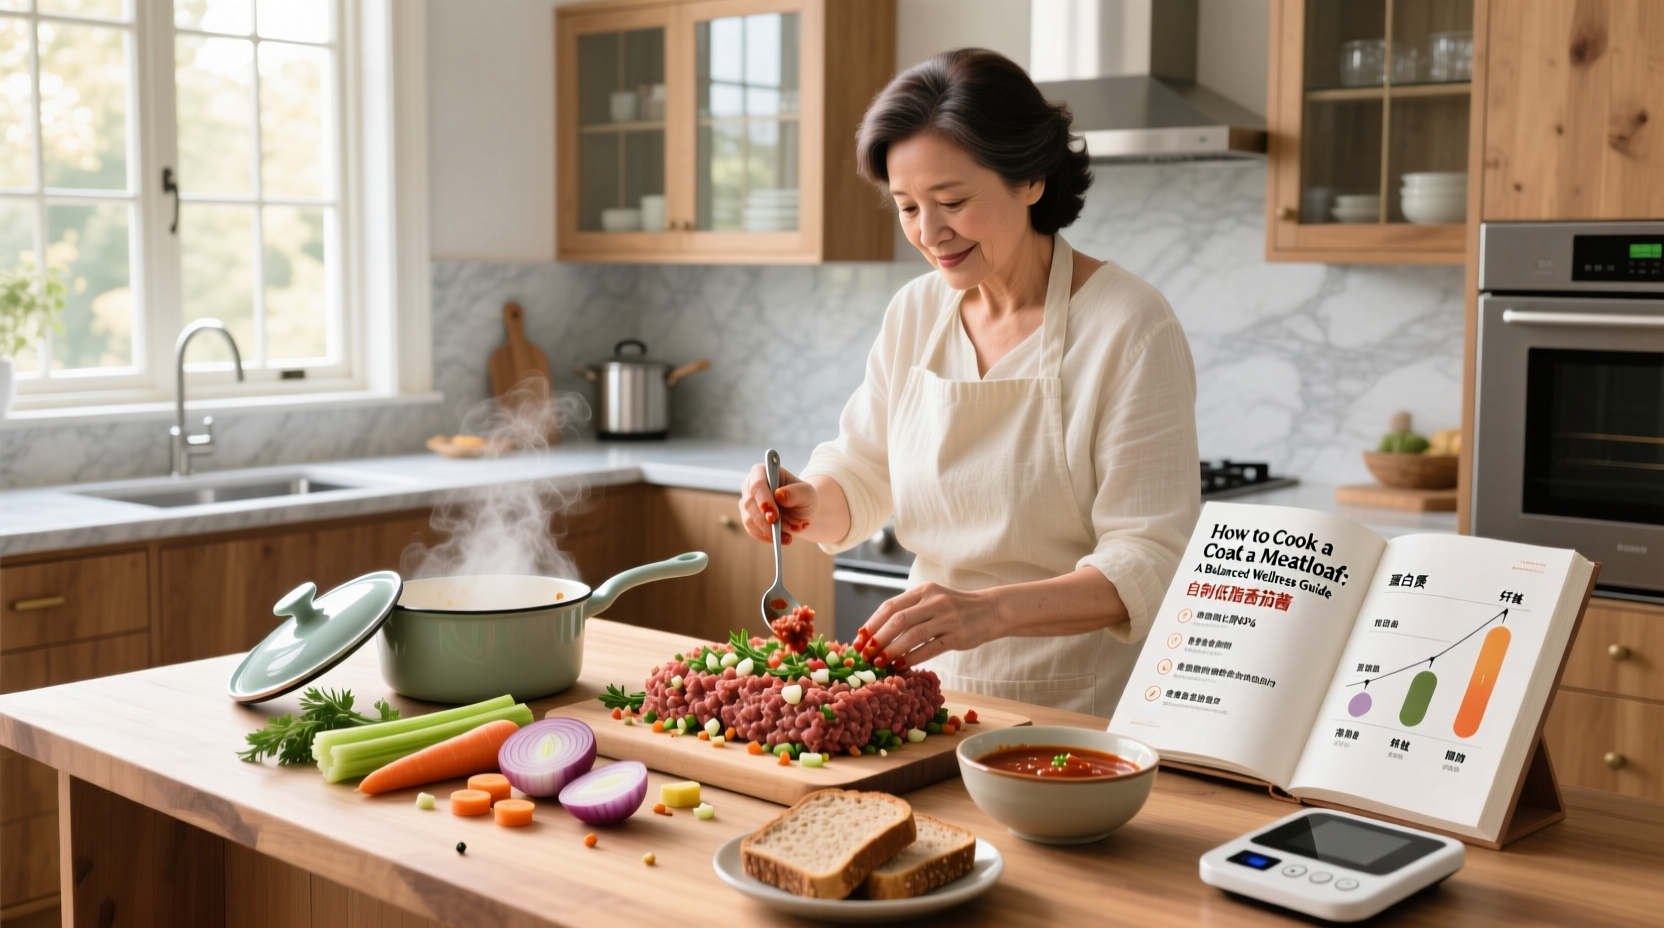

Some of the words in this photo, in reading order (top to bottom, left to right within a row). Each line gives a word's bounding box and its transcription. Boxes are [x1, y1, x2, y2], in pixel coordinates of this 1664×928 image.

[1210, 523, 1250, 541] How
[1252, 529, 1270, 543] to
[1272, 529, 1318, 552] Cook
[1321, 542, 1334, 556] a
[1245, 550, 1256, 563] a
[1194, 563, 1203, 573] A
[1299, 579, 1333, 599] Guide
